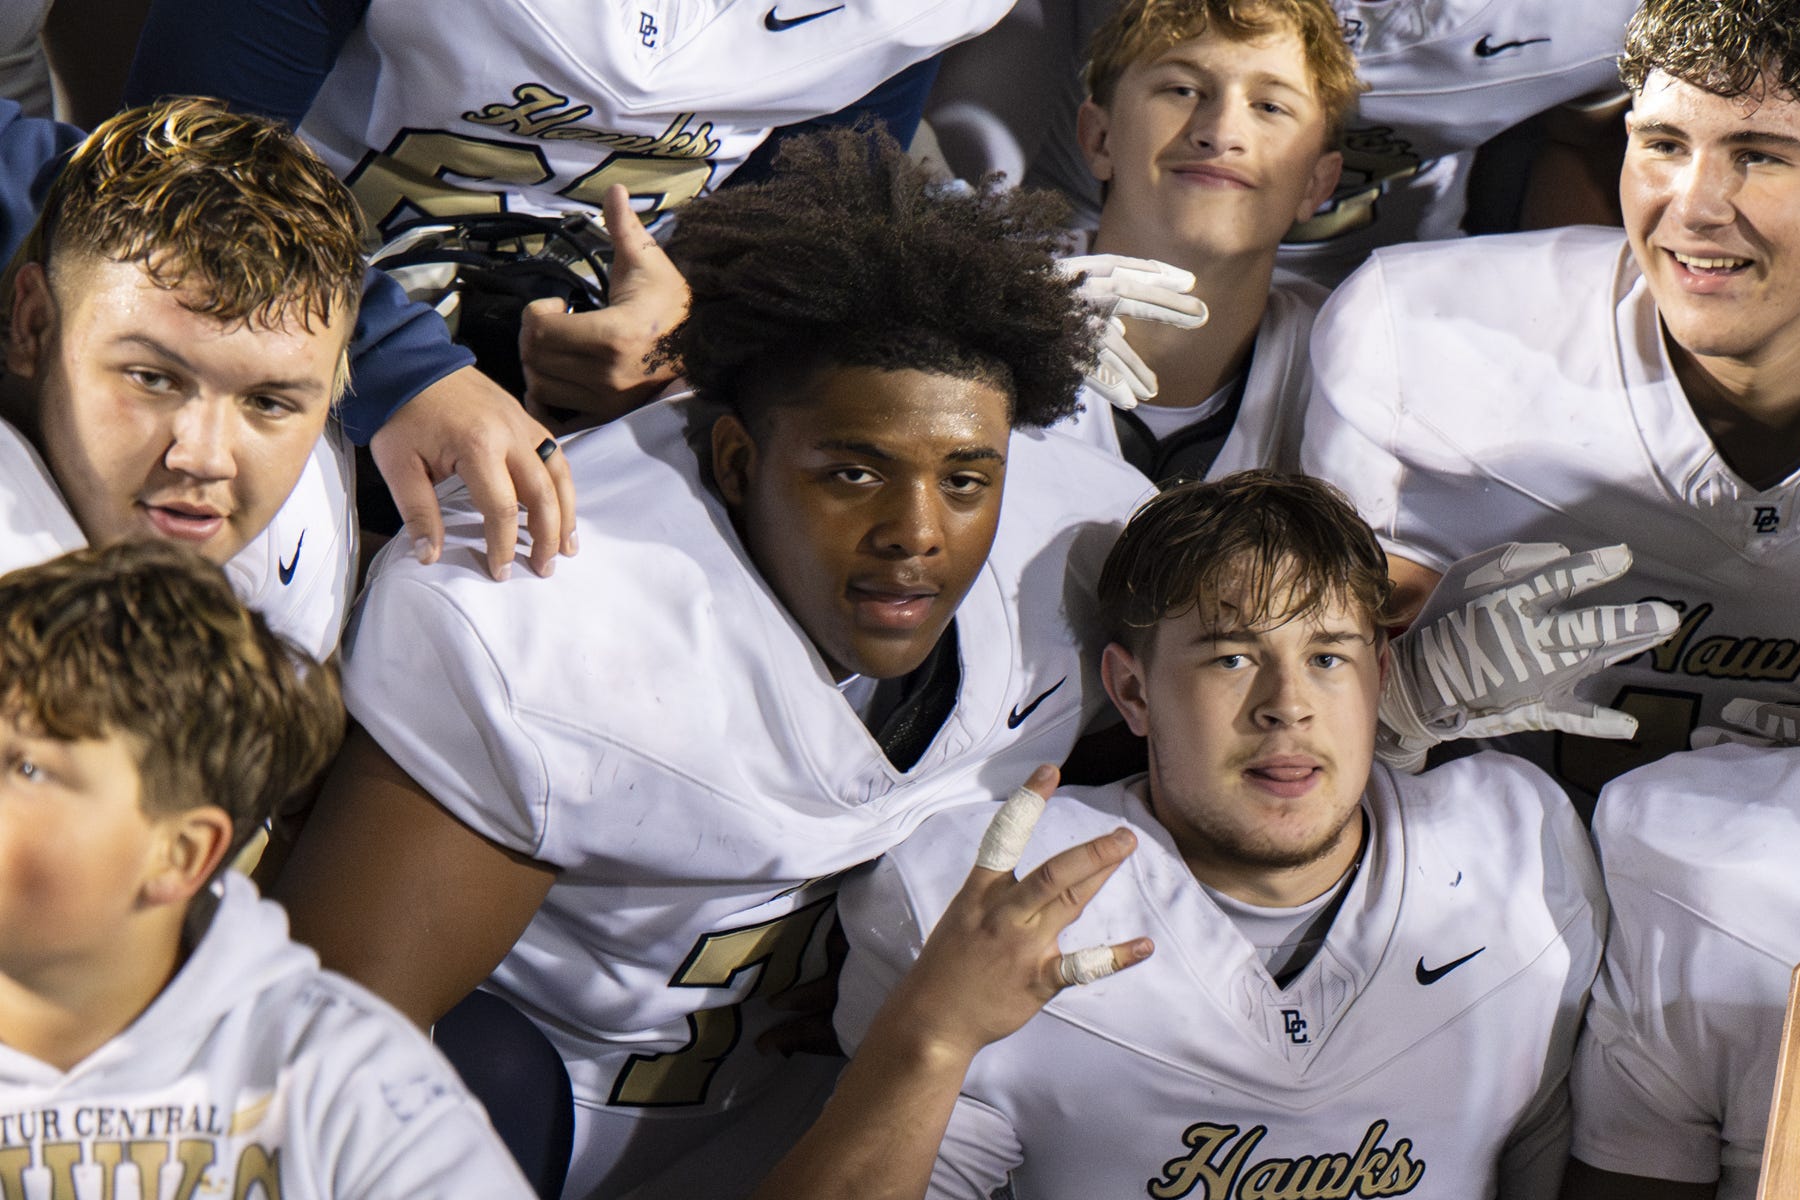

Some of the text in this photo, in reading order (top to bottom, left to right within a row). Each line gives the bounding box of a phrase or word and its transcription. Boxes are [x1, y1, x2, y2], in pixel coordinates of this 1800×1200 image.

[639, 11, 658, 49] DC
[462, 83, 722, 159] Hawks
[1753, 507, 1779, 534] DC
[1281, 1009, 1310, 1044] DC
[74, 1104, 223, 1138] CENTRAL
